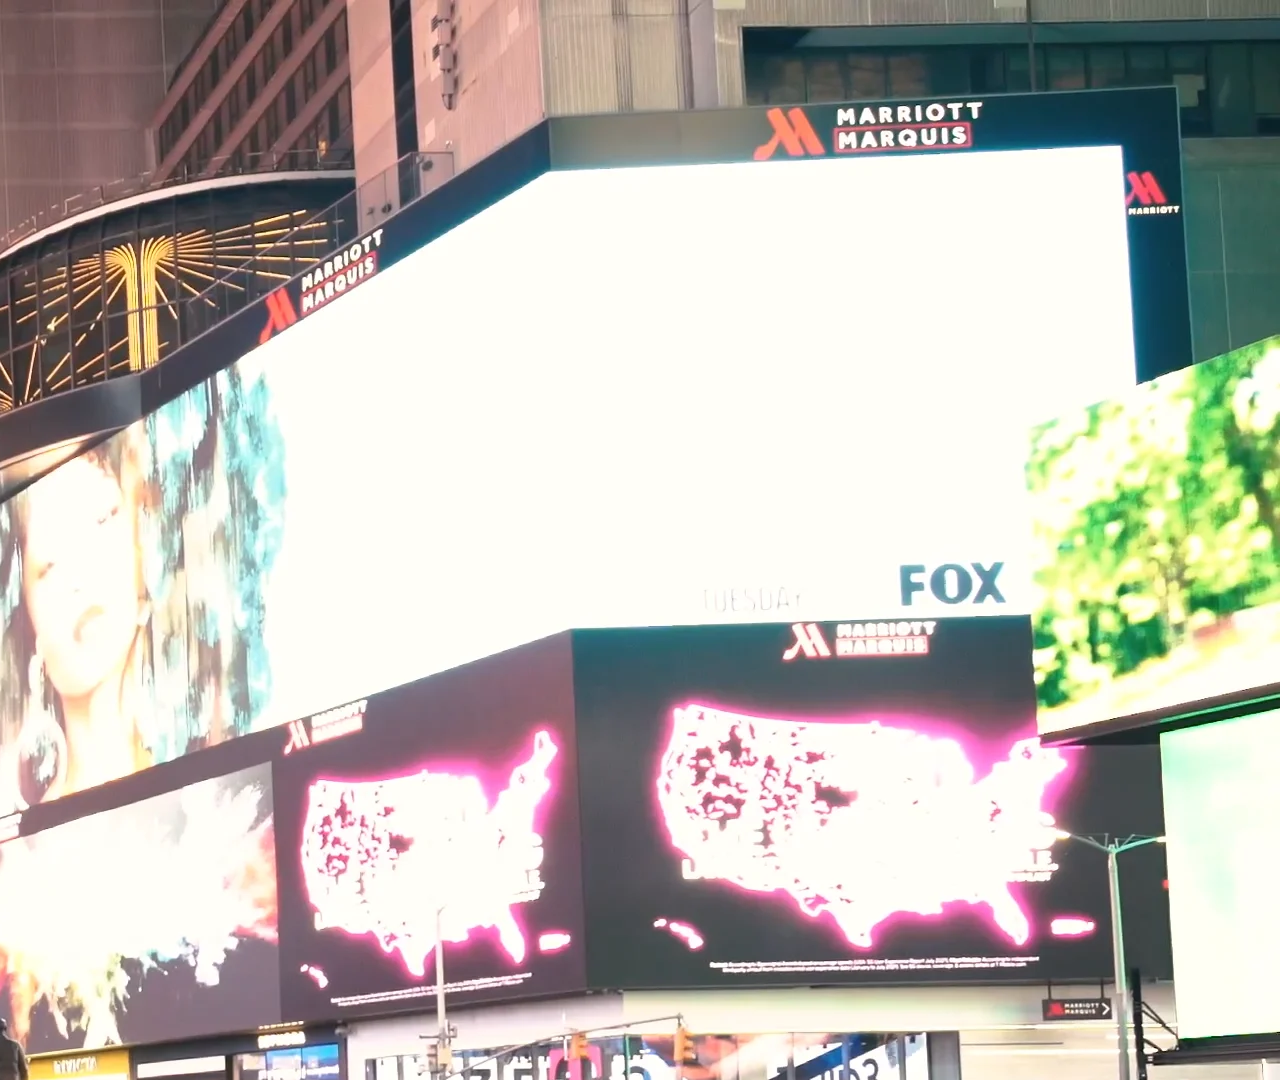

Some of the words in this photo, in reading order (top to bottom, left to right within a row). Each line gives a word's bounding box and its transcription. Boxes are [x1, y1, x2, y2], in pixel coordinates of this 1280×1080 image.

[837, 101, 983, 125] MARRIOTT
[838, 126, 967, 149] MARQUIS
[1128, 205, 1180, 215] MARRIOTT
[302, 228, 383, 292] MARRIOTT
[302, 256, 374, 312] MARQUIS
[899, 562, 1006, 606] FOX
[836, 621, 937, 639] MARRIOTT
[52, 1056, 98, 1074] INVICTA
